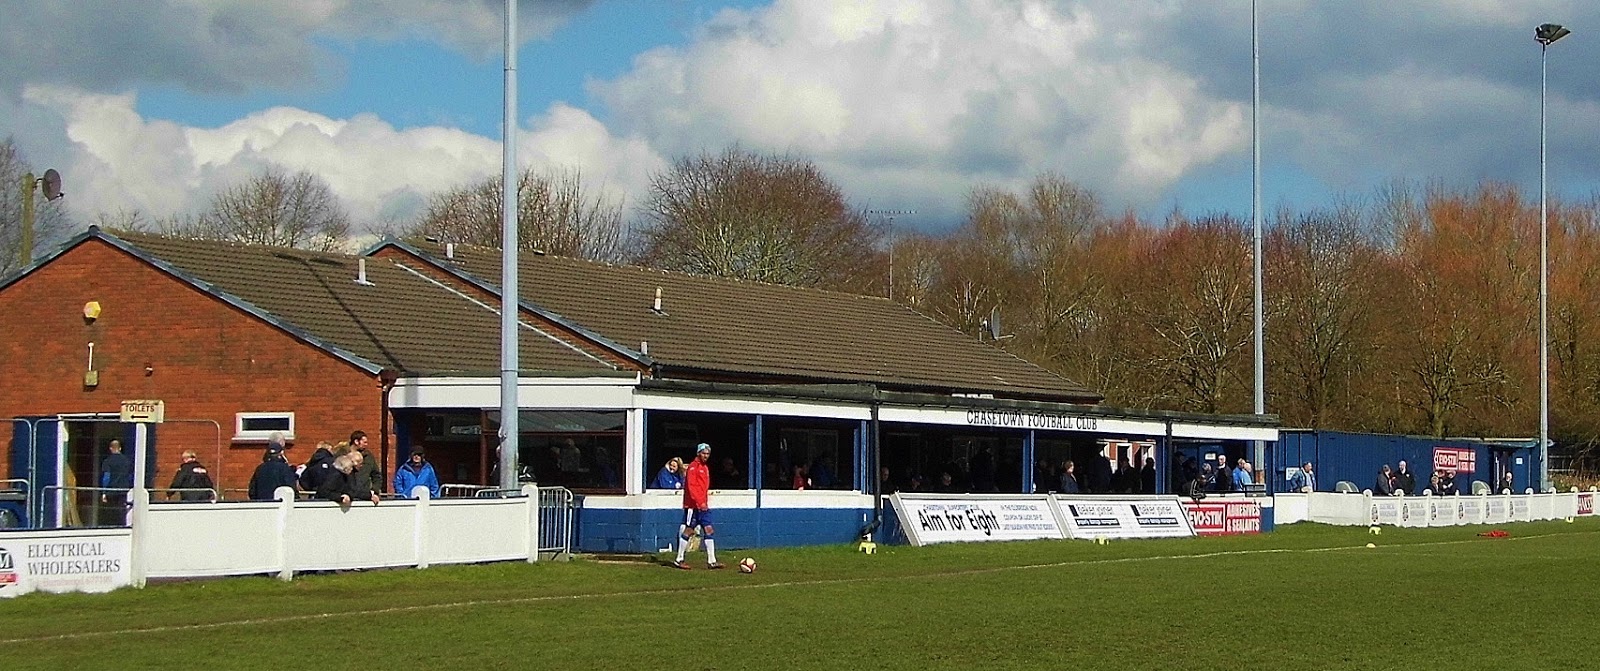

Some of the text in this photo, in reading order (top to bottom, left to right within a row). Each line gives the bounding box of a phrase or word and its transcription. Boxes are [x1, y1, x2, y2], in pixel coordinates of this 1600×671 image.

[125, 404, 155, 413] TOILETS
[966, 409, 1098, 431] CHASETOWN FOOTBALL CLUB
[918, 508, 1001, 536] Aim for Eight
[1232, 518, 1260, 532] SEALANTS
[28, 543, 105, 558] ELECTRICAL
[28, 559, 121, 575] WHOLESALERS
